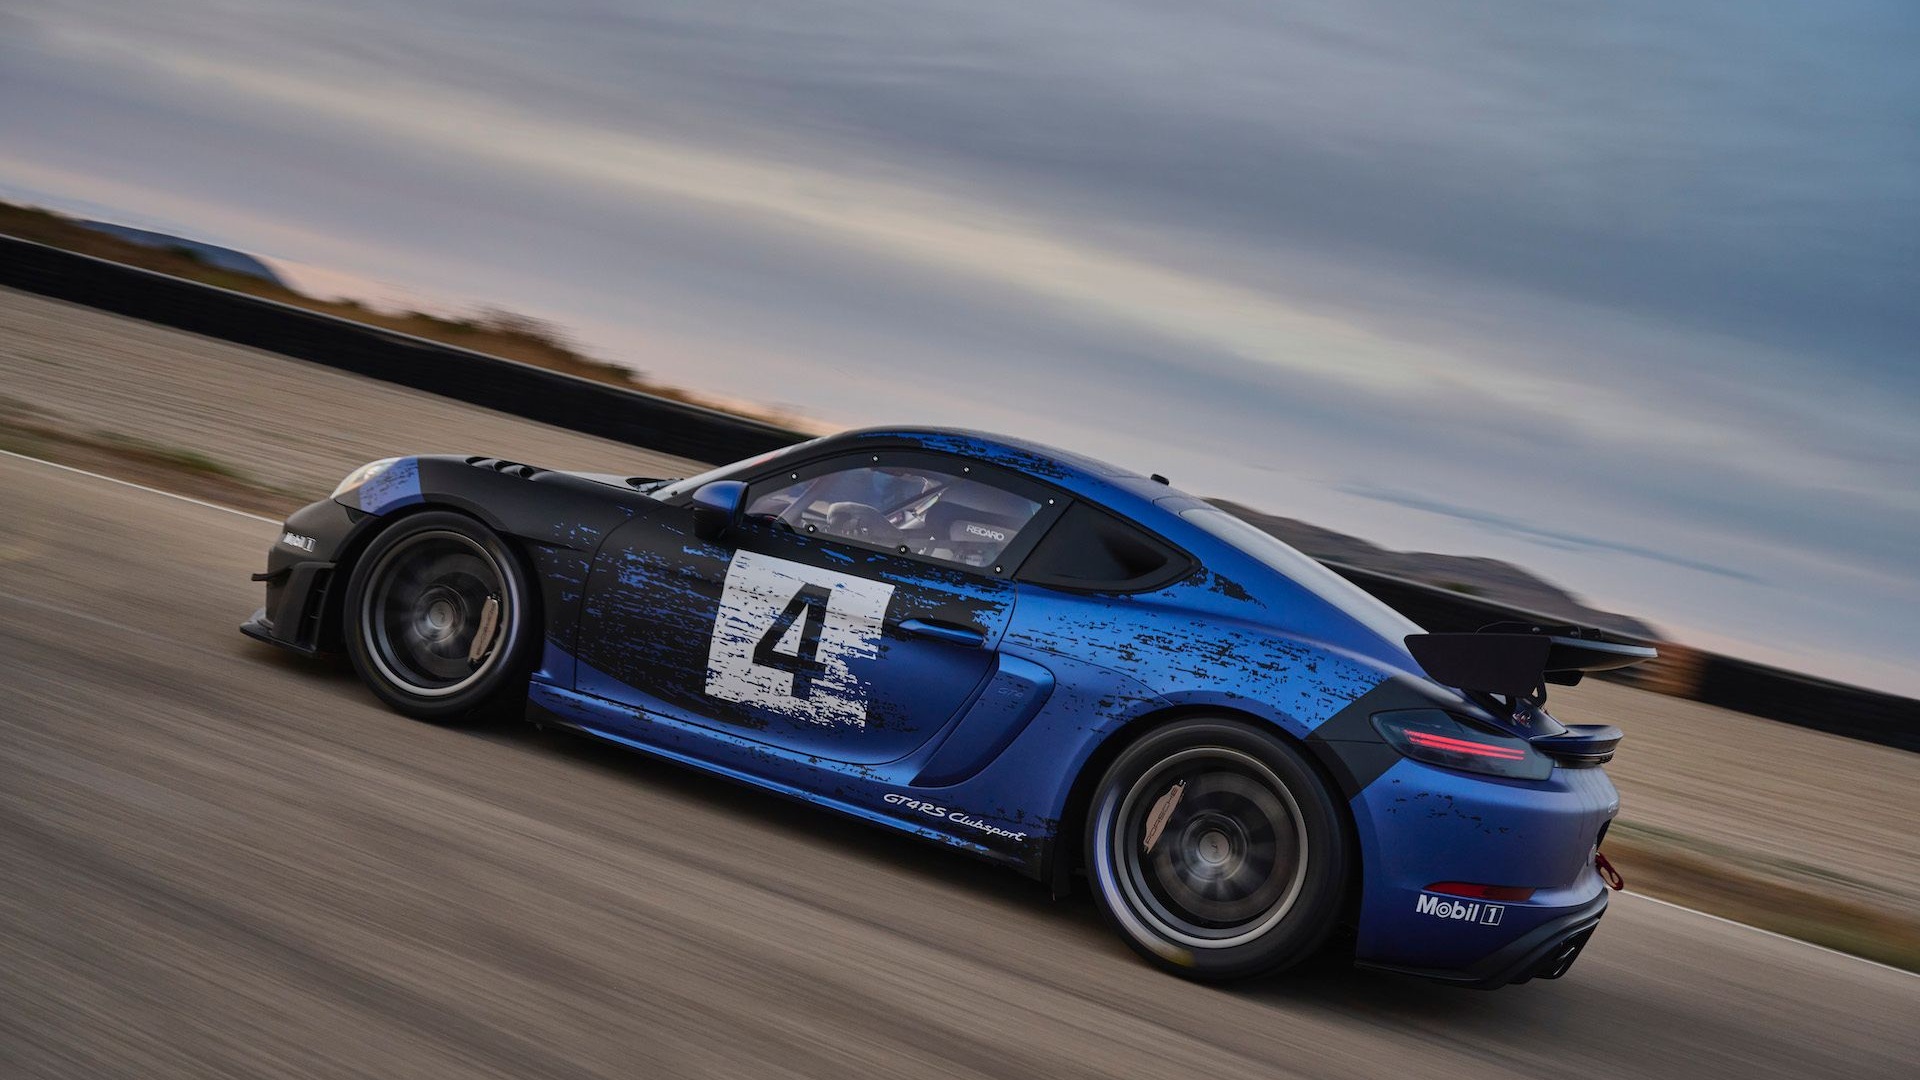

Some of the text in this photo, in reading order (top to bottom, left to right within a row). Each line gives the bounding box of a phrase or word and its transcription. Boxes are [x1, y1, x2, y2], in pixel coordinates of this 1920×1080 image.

[966, 524, 1005, 541] RECARO
[752, 582, 832, 702] 4
[948, 812, 1027, 842] Clubsport
[1145, 787, 1179, 844] PORSCHE
[1416, 894, 1480, 922] Mobil
